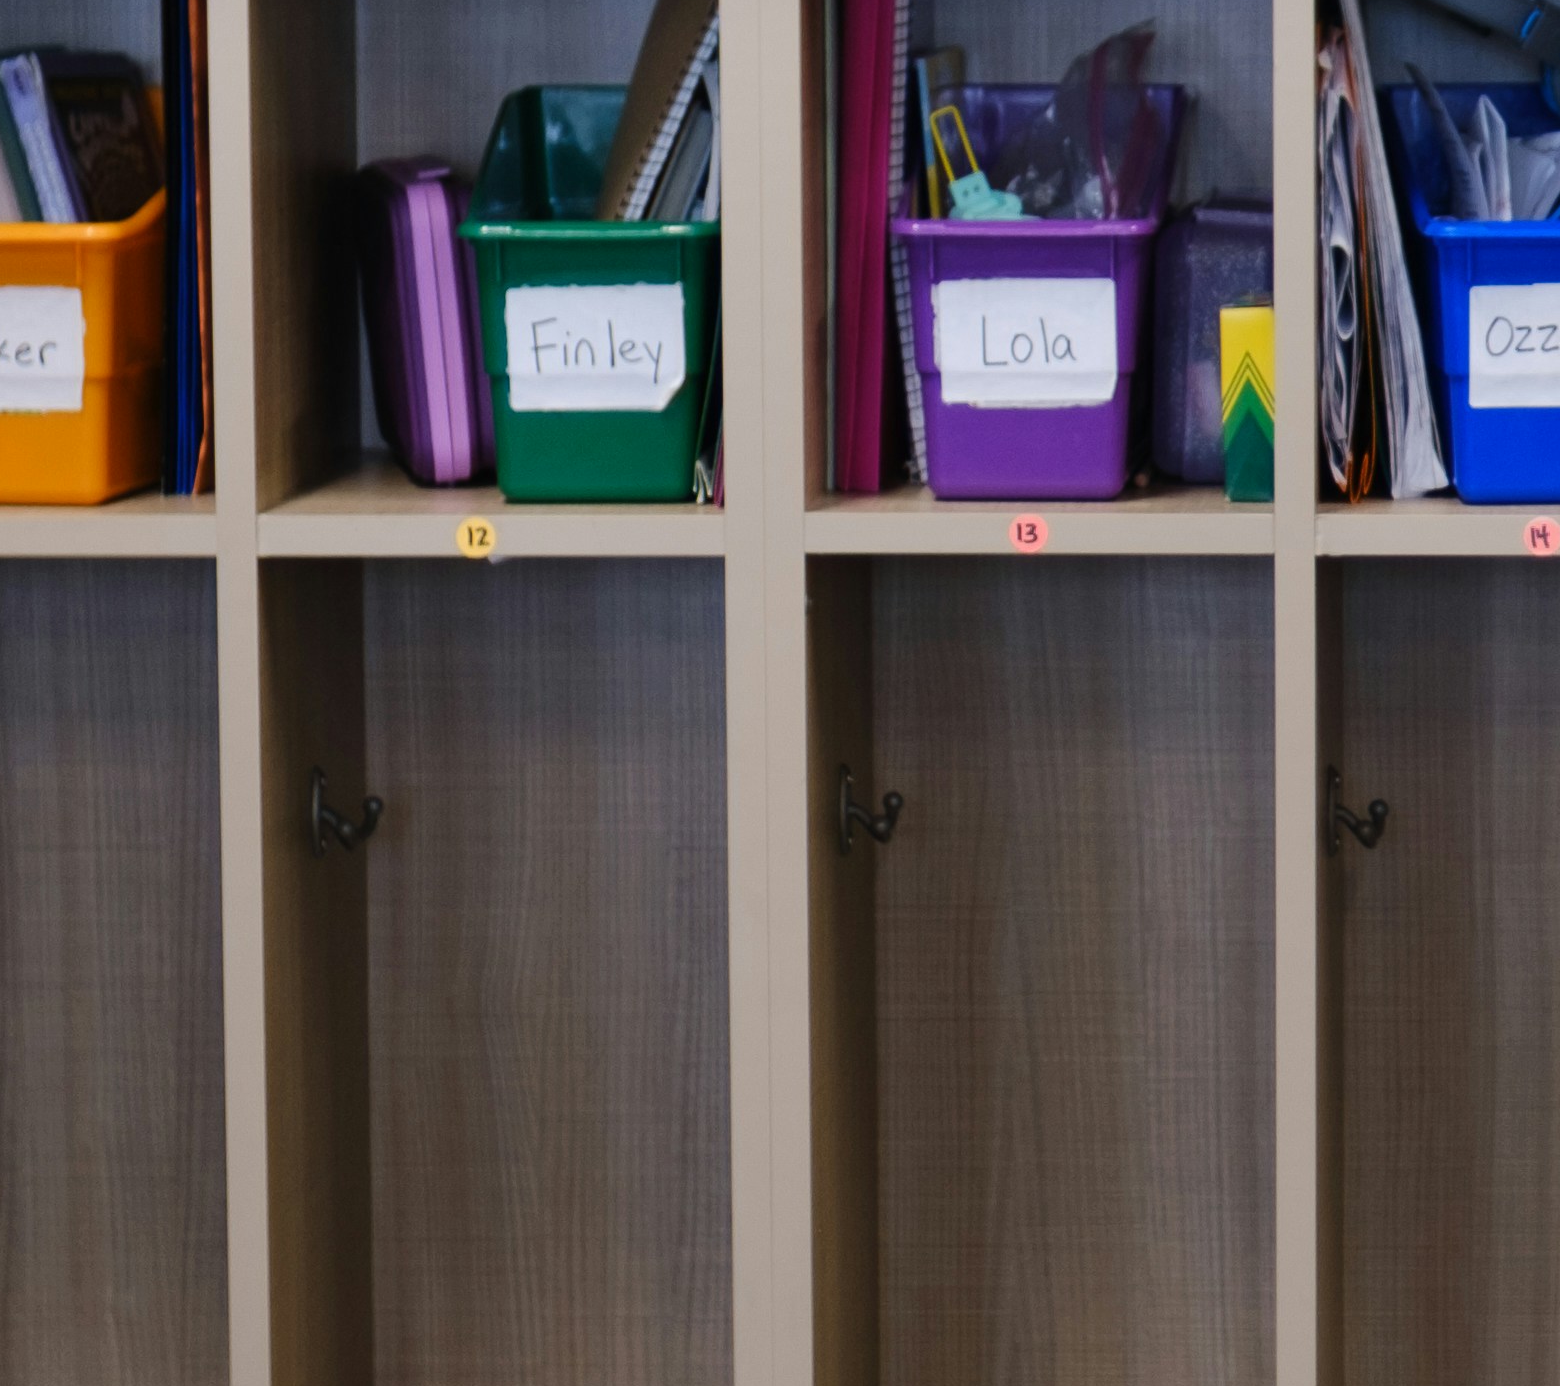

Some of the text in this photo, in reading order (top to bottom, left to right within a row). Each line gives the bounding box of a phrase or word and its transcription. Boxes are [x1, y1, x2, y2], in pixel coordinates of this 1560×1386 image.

[529, 316, 664, 385] Finley
[981, 315, 1078, 369] Lola
[464, 526, 491, 549] 12
[1014, 522, 1039, 544] 13
[1528, 525, 1552, 549] 14
